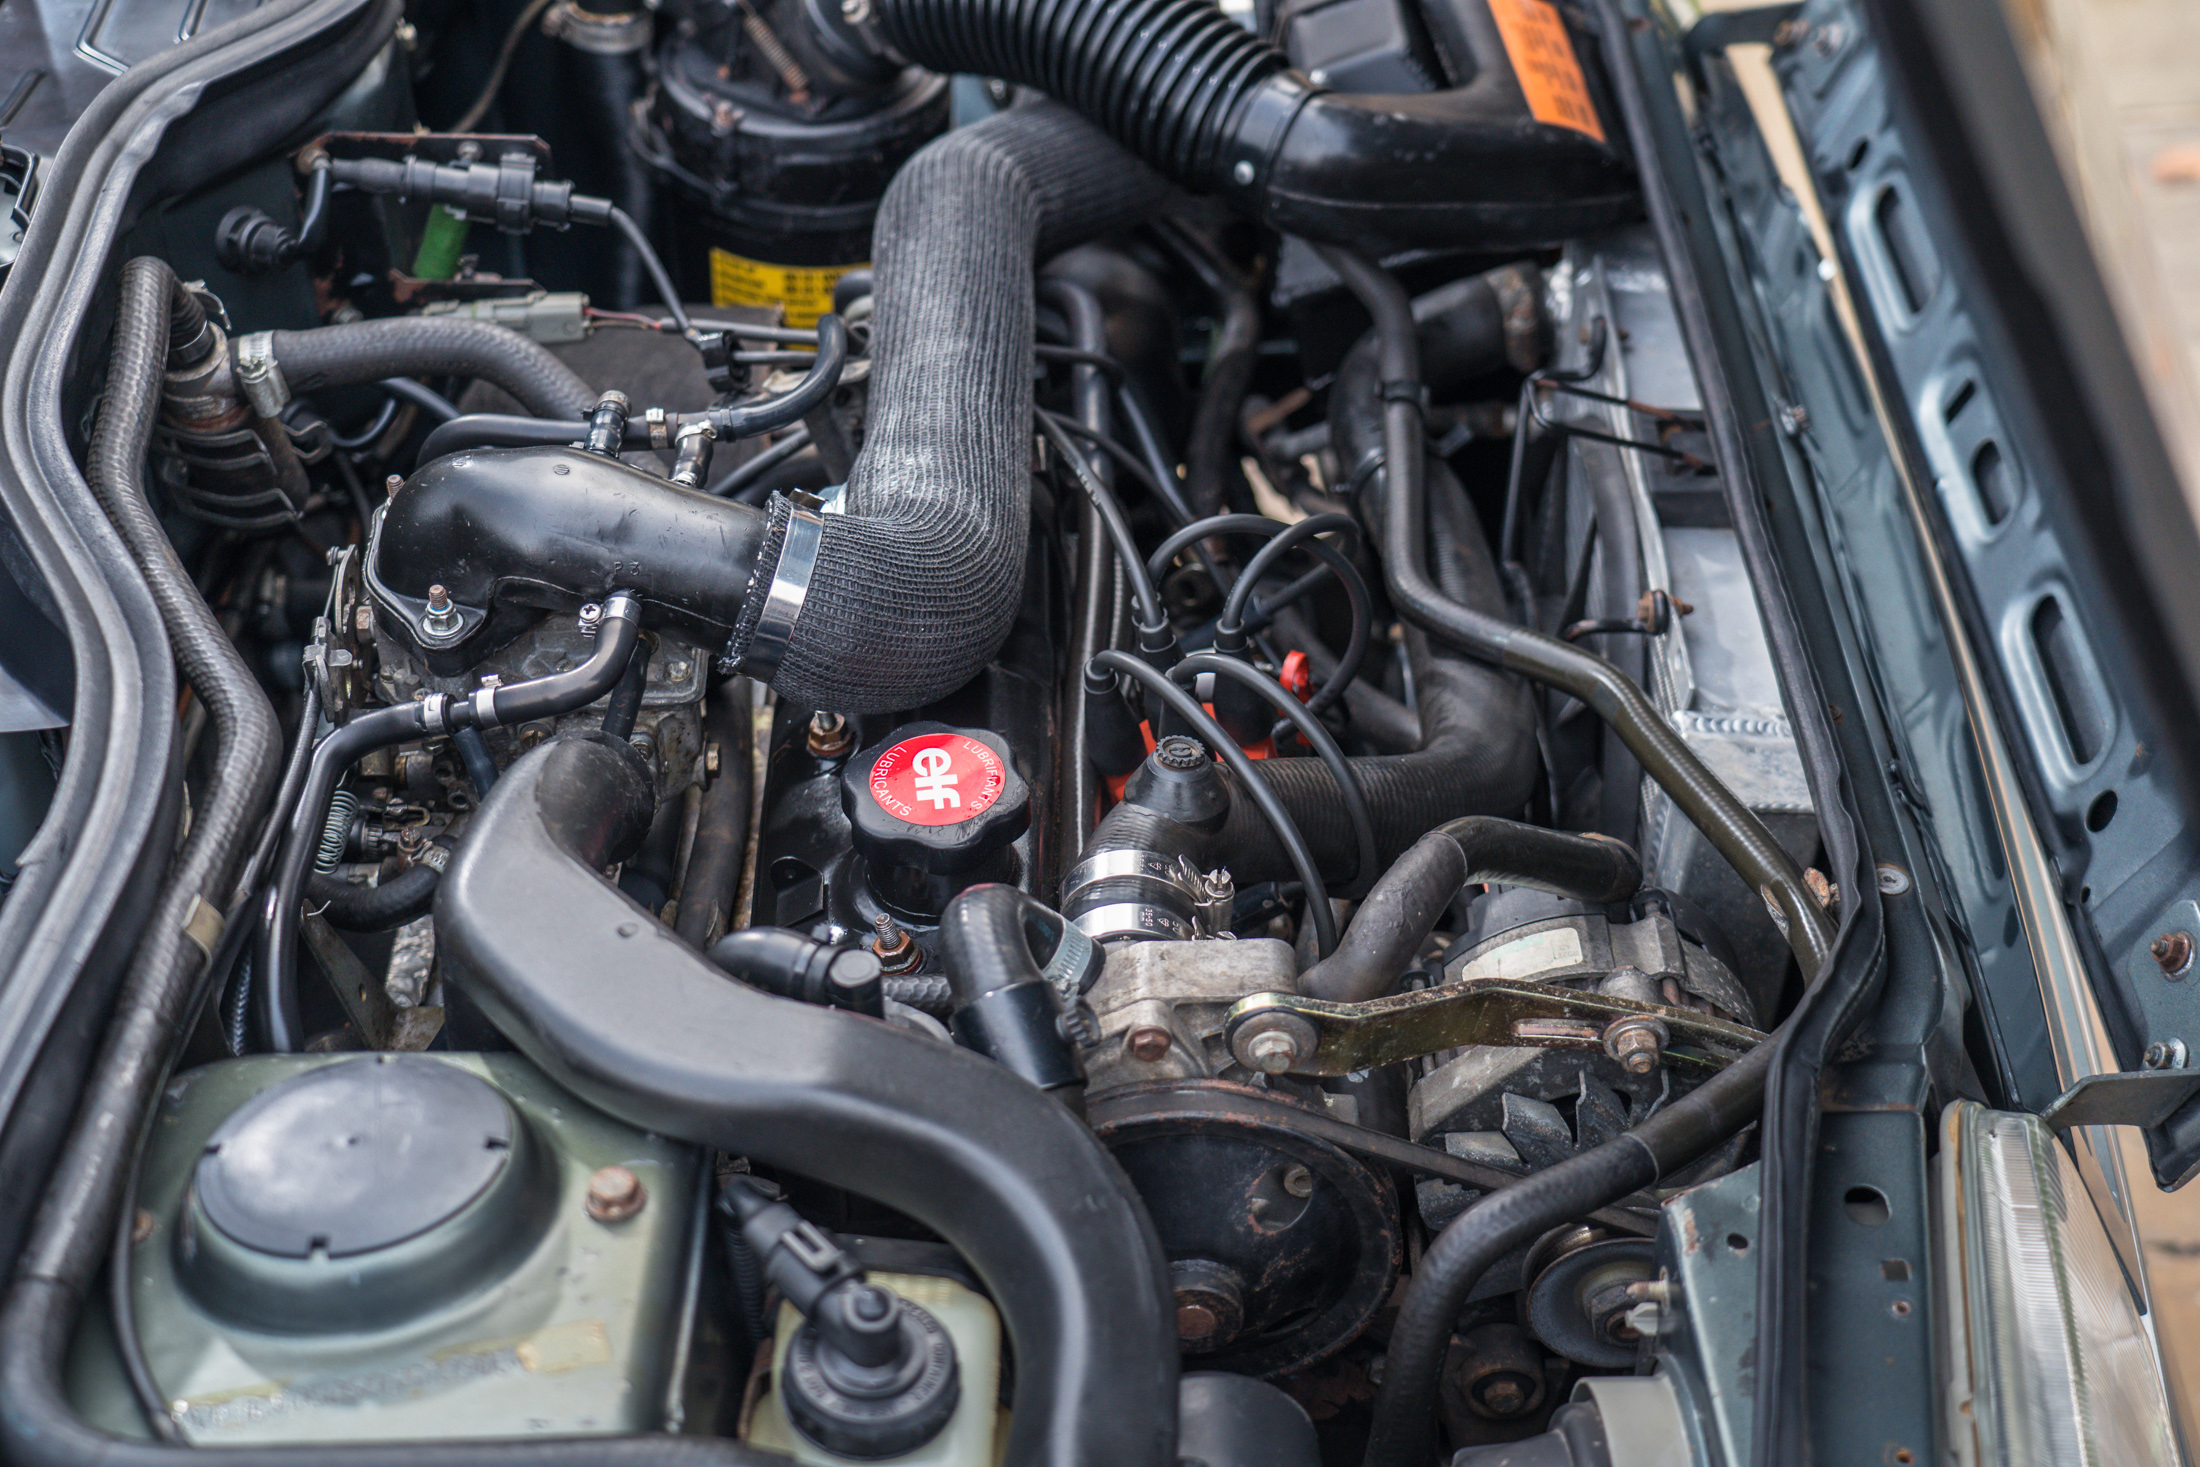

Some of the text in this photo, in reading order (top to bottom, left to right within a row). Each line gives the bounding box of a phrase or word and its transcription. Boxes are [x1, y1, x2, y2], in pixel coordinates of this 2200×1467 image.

[874, 746, 912, 816] LUBRICANTS
[912, 747, 961, 810] elf
[963, 741, 998, 810] LUBRIFIANTS
